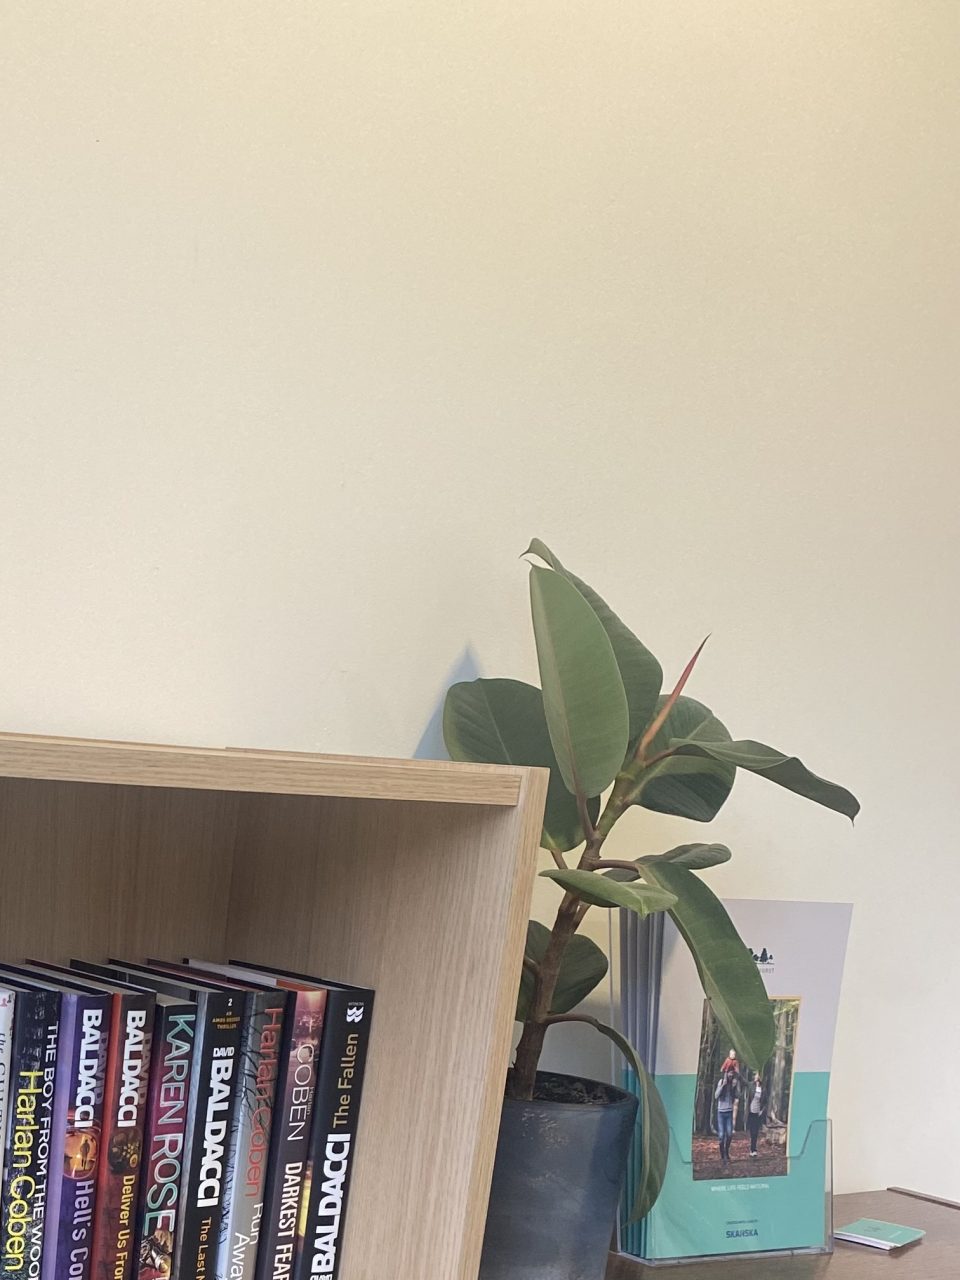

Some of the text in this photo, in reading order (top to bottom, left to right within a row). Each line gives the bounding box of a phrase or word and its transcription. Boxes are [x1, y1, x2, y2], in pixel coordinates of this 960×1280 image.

[74, 1008, 103, 1128] BALDACCI
[212, 1046, 235, 1057] DAVID
[337, 1033, 359, 1089] Fallen
[143, 1014, 196, 1236] KAREN ROSE
[197, 1058, 234, 1208] BALDACCI
[332, 1095, 351, 1129] The
[4, 1070, 44, 1271] Harlan Coben
[72, 1179, 94, 1242] Hell's
[119, 1174, 136, 1226] Deliver
[310, 1133, 351, 1274] BALDACCI
[117, 1229, 131, 1249] Us
[199, 1217, 212, 1241] The
[196, 1244, 209, 1272] Last
